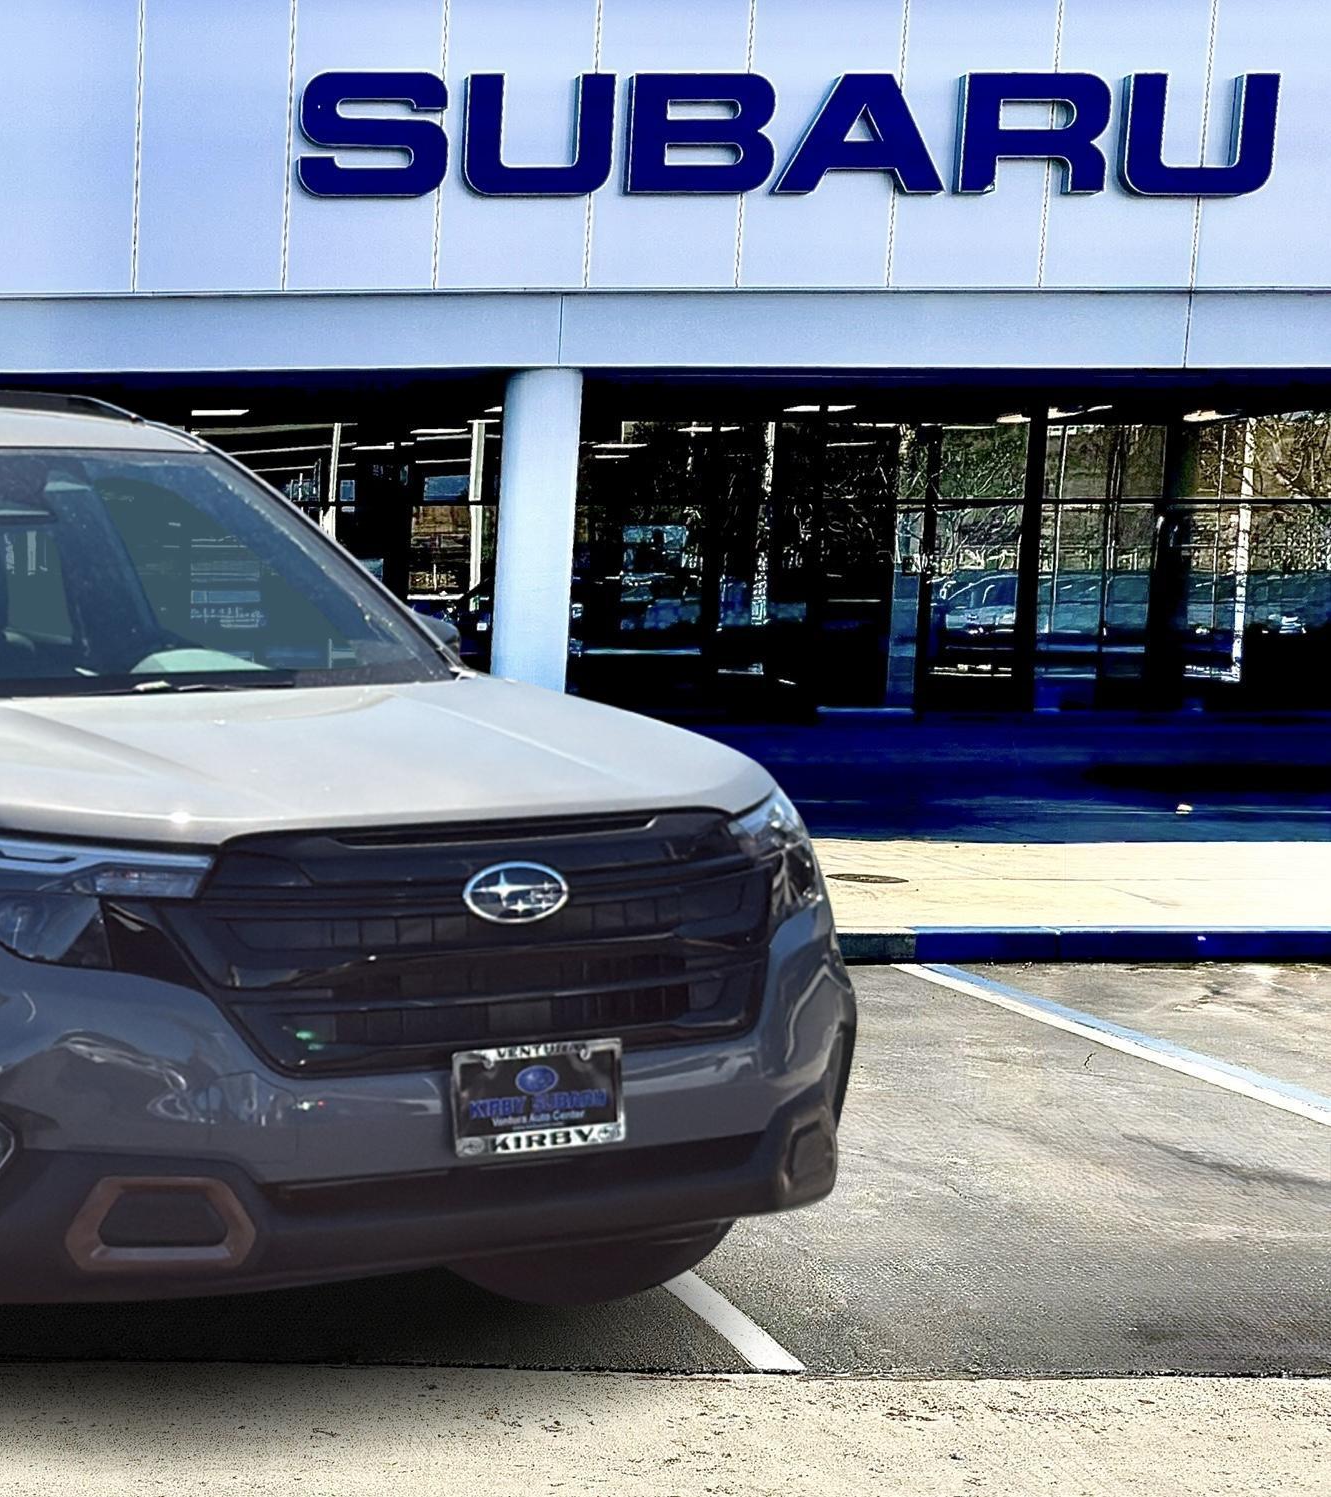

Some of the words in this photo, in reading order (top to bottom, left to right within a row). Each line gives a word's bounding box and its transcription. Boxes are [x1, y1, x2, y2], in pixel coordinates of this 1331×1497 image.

[297, 71, 1281, 197] SUBARU
[470, 1096, 527, 1119] KIRBY
[529, 1112, 550, 1122] Auto
[552, 1109, 585, 1121] Center
[491, 1127, 593, 1152] KIRBY
